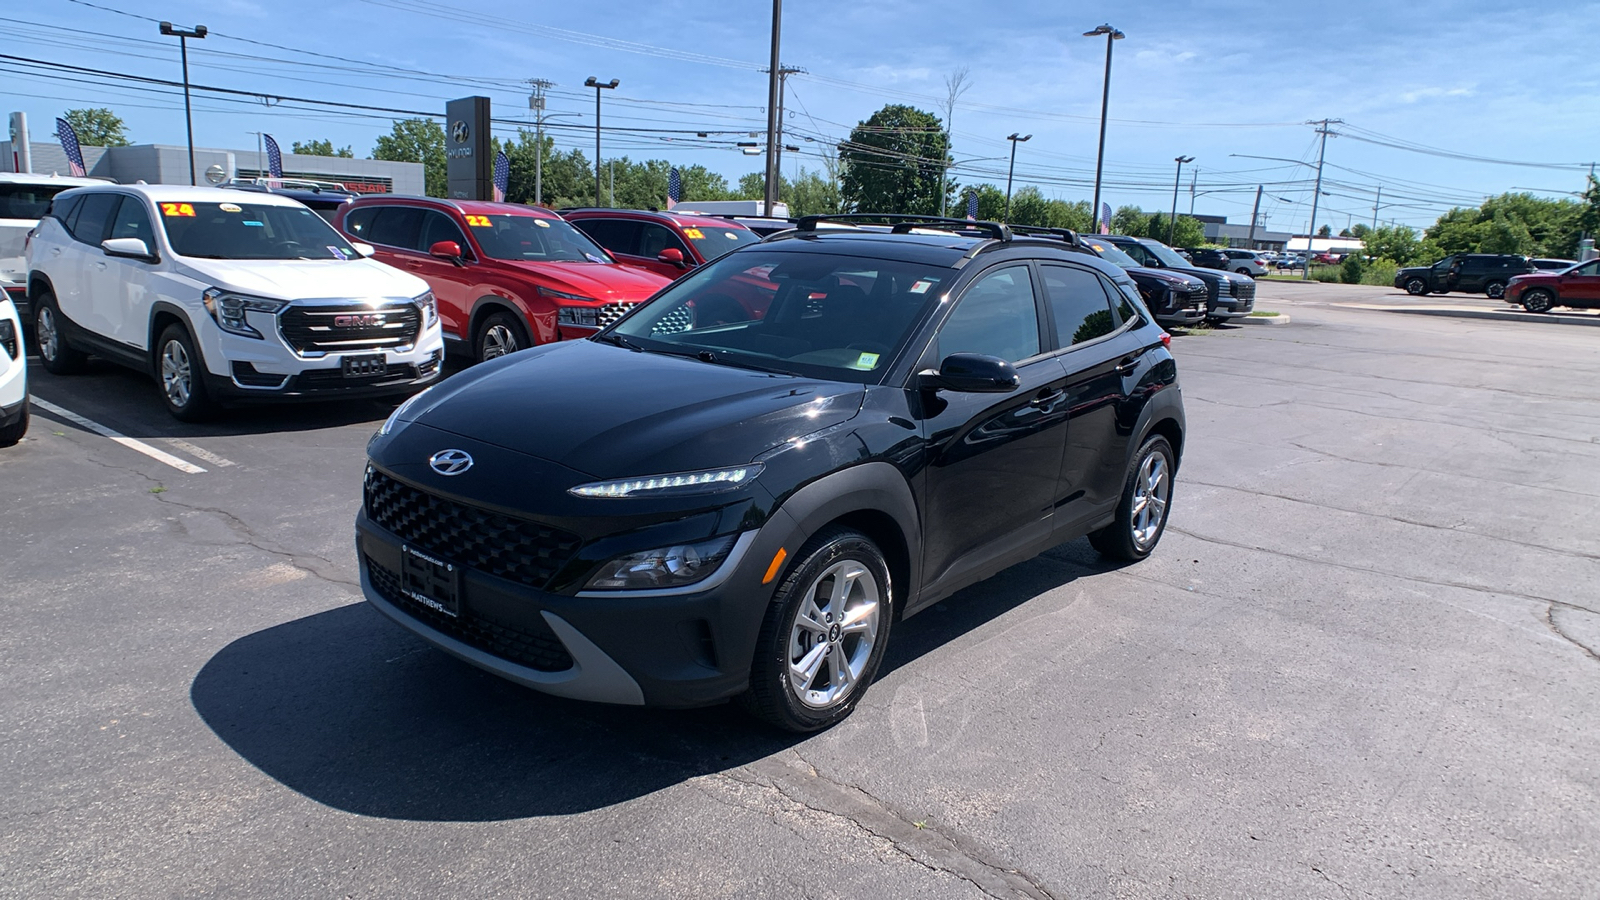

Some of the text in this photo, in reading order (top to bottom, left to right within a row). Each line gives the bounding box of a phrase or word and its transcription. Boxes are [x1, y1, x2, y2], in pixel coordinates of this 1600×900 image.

[162, 203, 195, 216] 24
[464, 215, 492, 226] 22
[683, 228, 704, 239] 23
[334, 314, 386, 328] GMC
[411, 591, 443, 612] MATTHEWS
